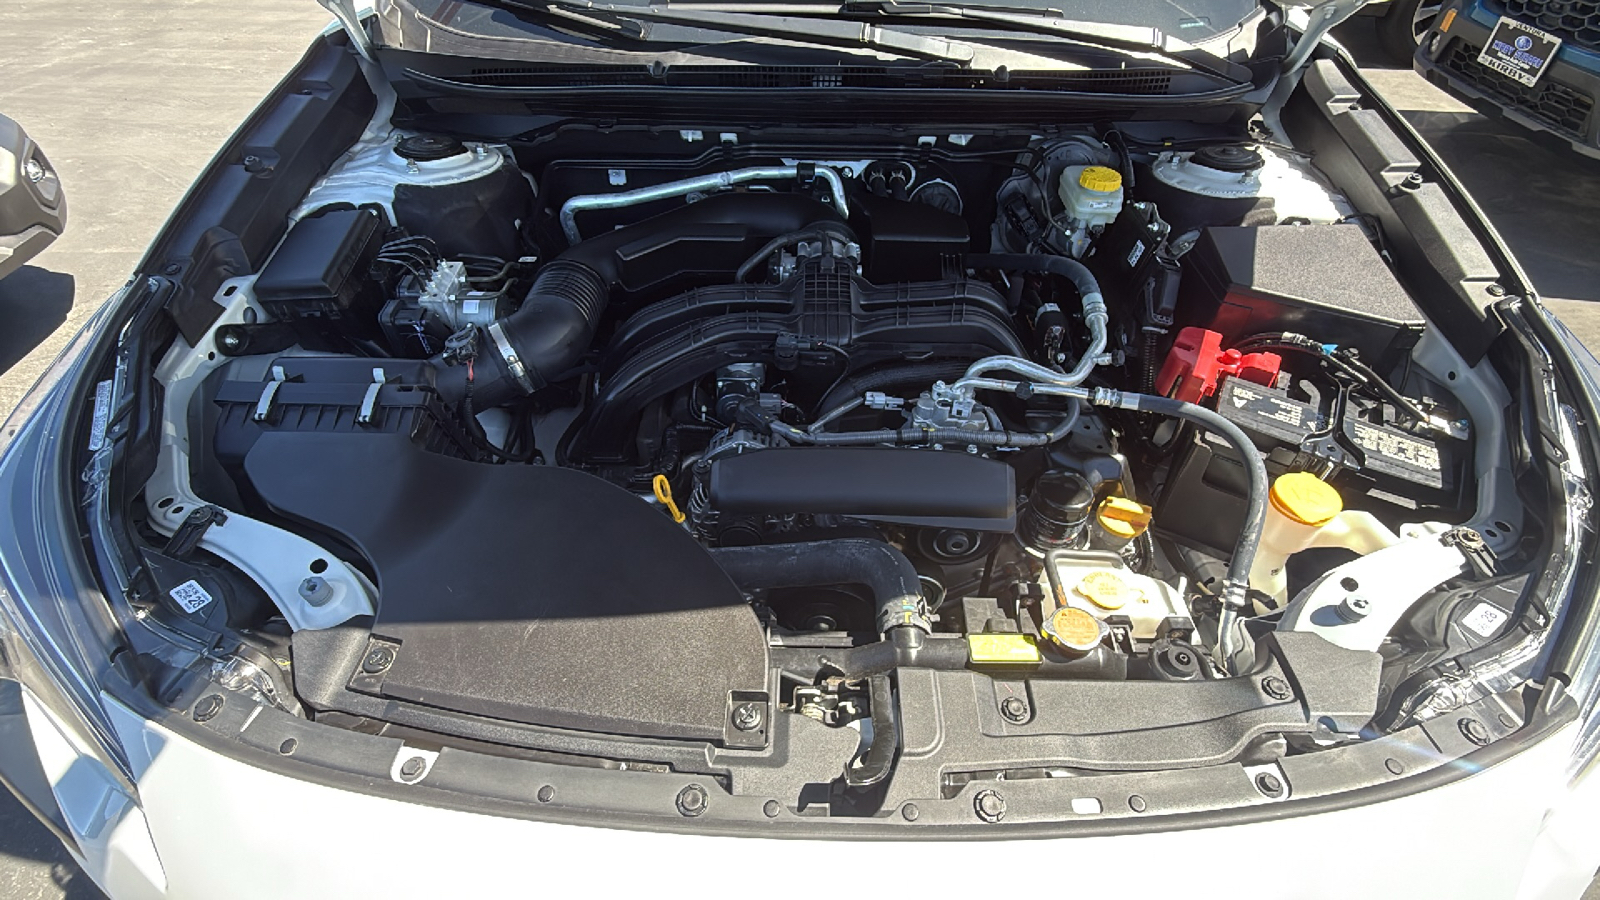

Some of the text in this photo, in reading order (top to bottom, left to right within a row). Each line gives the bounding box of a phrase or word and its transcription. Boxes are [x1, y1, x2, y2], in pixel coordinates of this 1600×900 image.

[1515, 21, 1546, 38] VENTURA
[1492, 40, 1515, 55] KIRBY
[1514, 50, 1543, 68] SUBARU
[1488, 59, 1526, 80] KIRBY
[188, 595, 205, 608] 28
[1481, 610, 1497, 623] 28
